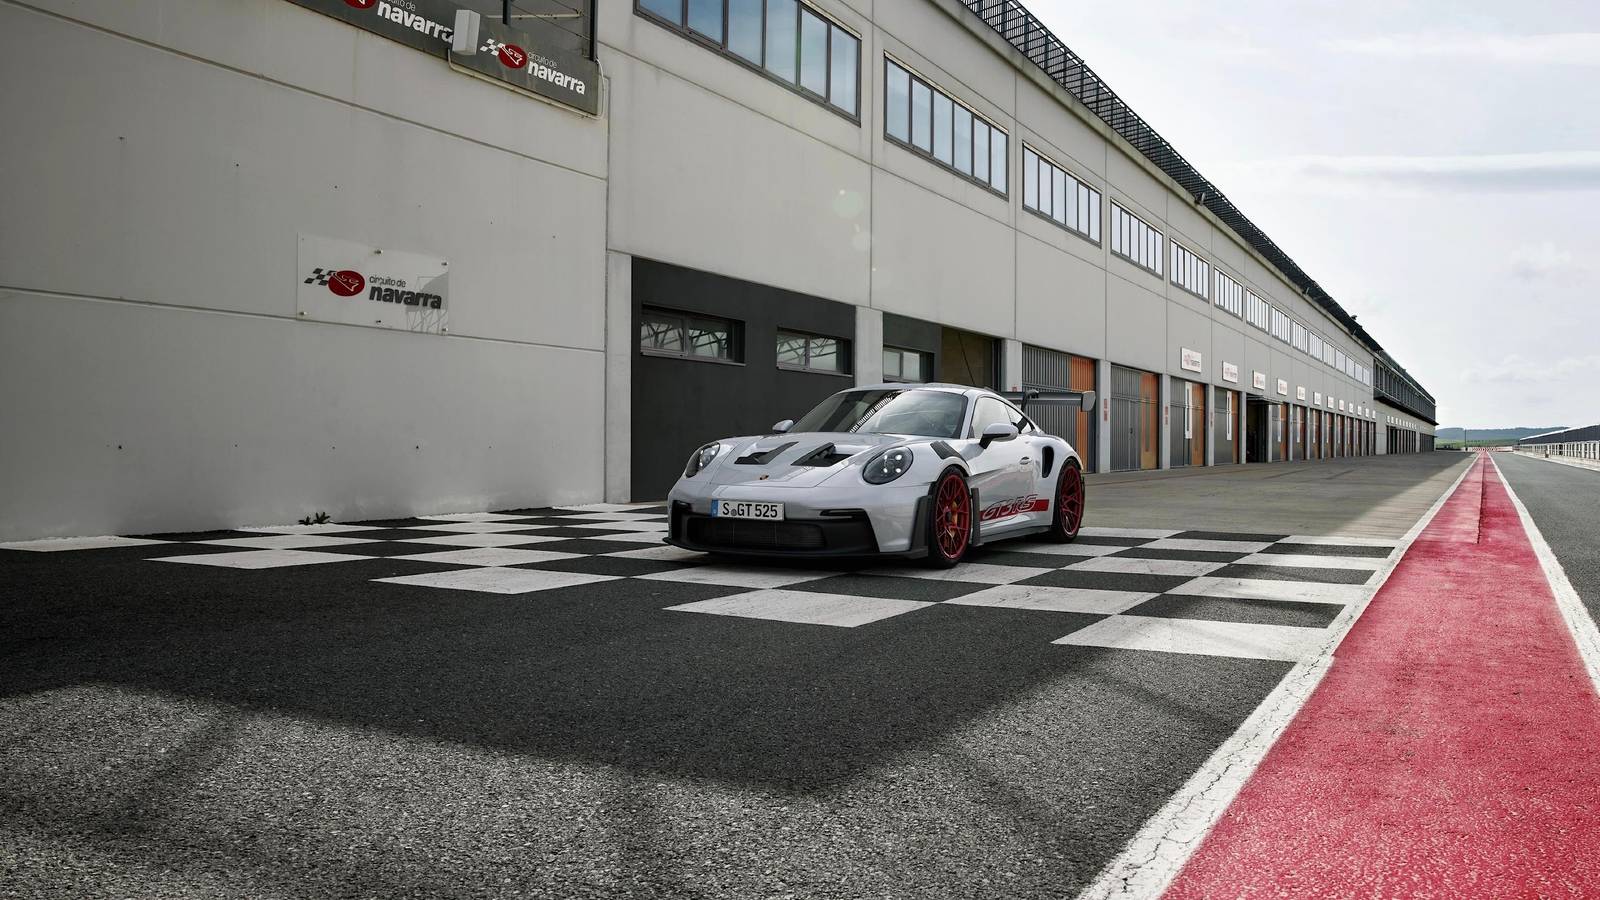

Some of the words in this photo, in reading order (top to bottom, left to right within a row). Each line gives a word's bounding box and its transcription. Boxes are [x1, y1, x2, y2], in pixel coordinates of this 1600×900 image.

[405, 2, 416, 11] de
[377, 1, 454, 44] navarra
[527, 61, 586, 95] navarra
[369, 275, 396, 286] circuito
[396, 278, 407, 288] de
[368, 286, 442, 309] navarra
[722, 502, 730, 516] S
[737, 503, 753, 517] GT
[754, 503, 778, 518] 525
